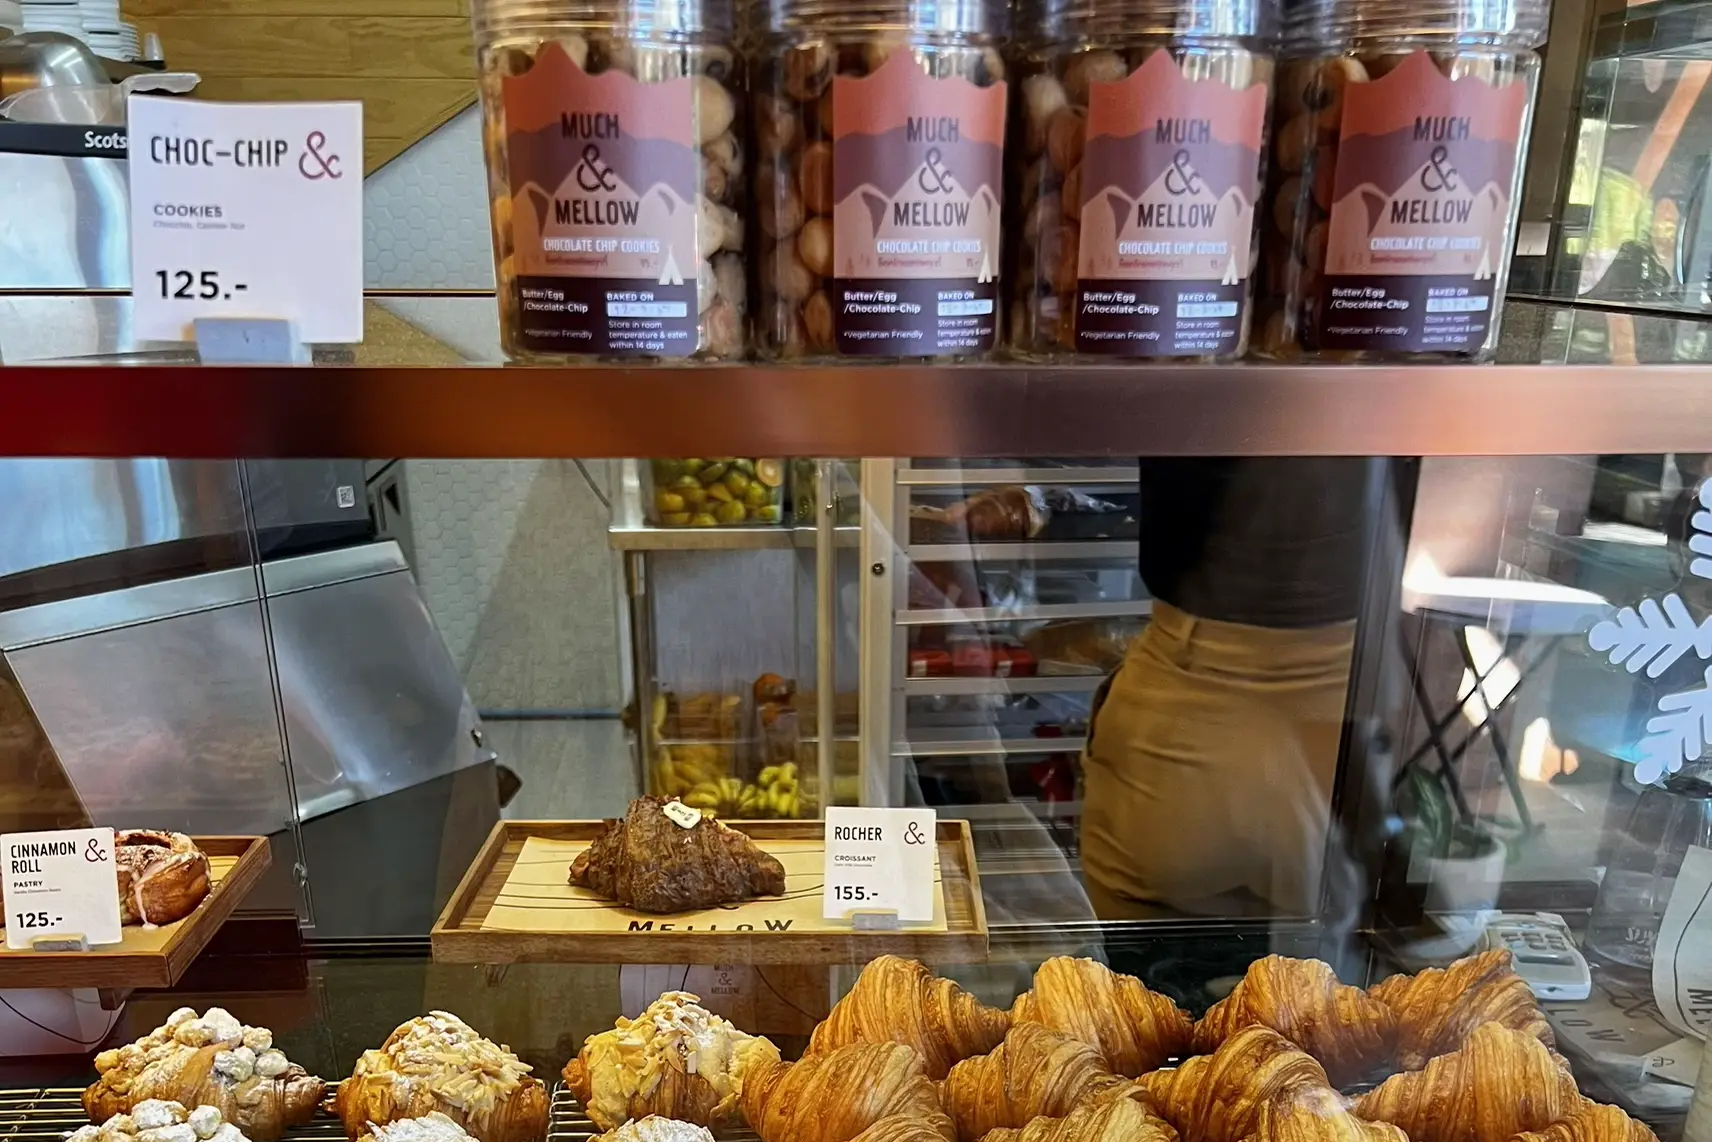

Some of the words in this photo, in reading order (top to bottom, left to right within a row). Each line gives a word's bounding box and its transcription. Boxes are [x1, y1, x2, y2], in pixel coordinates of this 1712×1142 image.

[561, 112, 620, 139] MUCH
[907, 117, 959, 142] MUCH
[1156, 118, 1211, 144] MUCH
[1413, 116, 1471, 141] MUCH
[150, 136, 289, 167] CHOC-CHIP
[299, 131, 343, 180] &
[577, 143, 617, 193] &
[919, 147, 953, 194] &
[1165, 148, 1200, 195] &
[1420, 145, 1458, 192] &
[154, 205, 223, 218] COOKIES
[555, 200, 639, 226] MELLOW
[893, 202, 970, 227] MELLOW
[1137, 203, 1217, 228] MELLOW
[1390, 200, 1473, 224] MELLOW
[544, 238, 592, 252] CHOCOLATE
[596, 239, 618, 253] CHIP
[621, 240, 660, 254] COOKIES
[877, 239, 929, 253] CHOCOLATE
[1119, 241, 1171, 255] CHOCOLATE
[156, 270, 248, 300] 125.-
[606, 292, 637, 301] BAKED
[639, 292, 654, 301] ON
[844, 291, 897, 302] Butter/Egg
[937, 292, 962, 300] BAKED
[1083, 293, 1136, 303] Butter/Egg
[523, 302, 588, 313] /Chocolate-Chip
[844, 304, 921, 314] /Chocolate-Chip
[1082, 304, 1160, 316] /Chocolate-Chip
[1330, 300, 1409, 310] /Chocolate-Chip
[608, 321, 630, 329] Store
[609, 331, 658, 341] temperature
[891, 330, 923, 340] Friendly
[1127, 332, 1160, 341] Friendly
[609, 341, 635, 349] within
[645, 341, 664, 351] days
[834, 826, 882, 841] ROCHER
[904, 821, 926, 845] &
[10, 841, 76, 858] CINNAMON
[85, 838, 107, 862] &
[12, 860, 42, 874] ROLL
[14, 880, 42, 888] PASTRY
[834, 886, 879, 900] 155.-
[16, 912, 63, 928] 125.-
